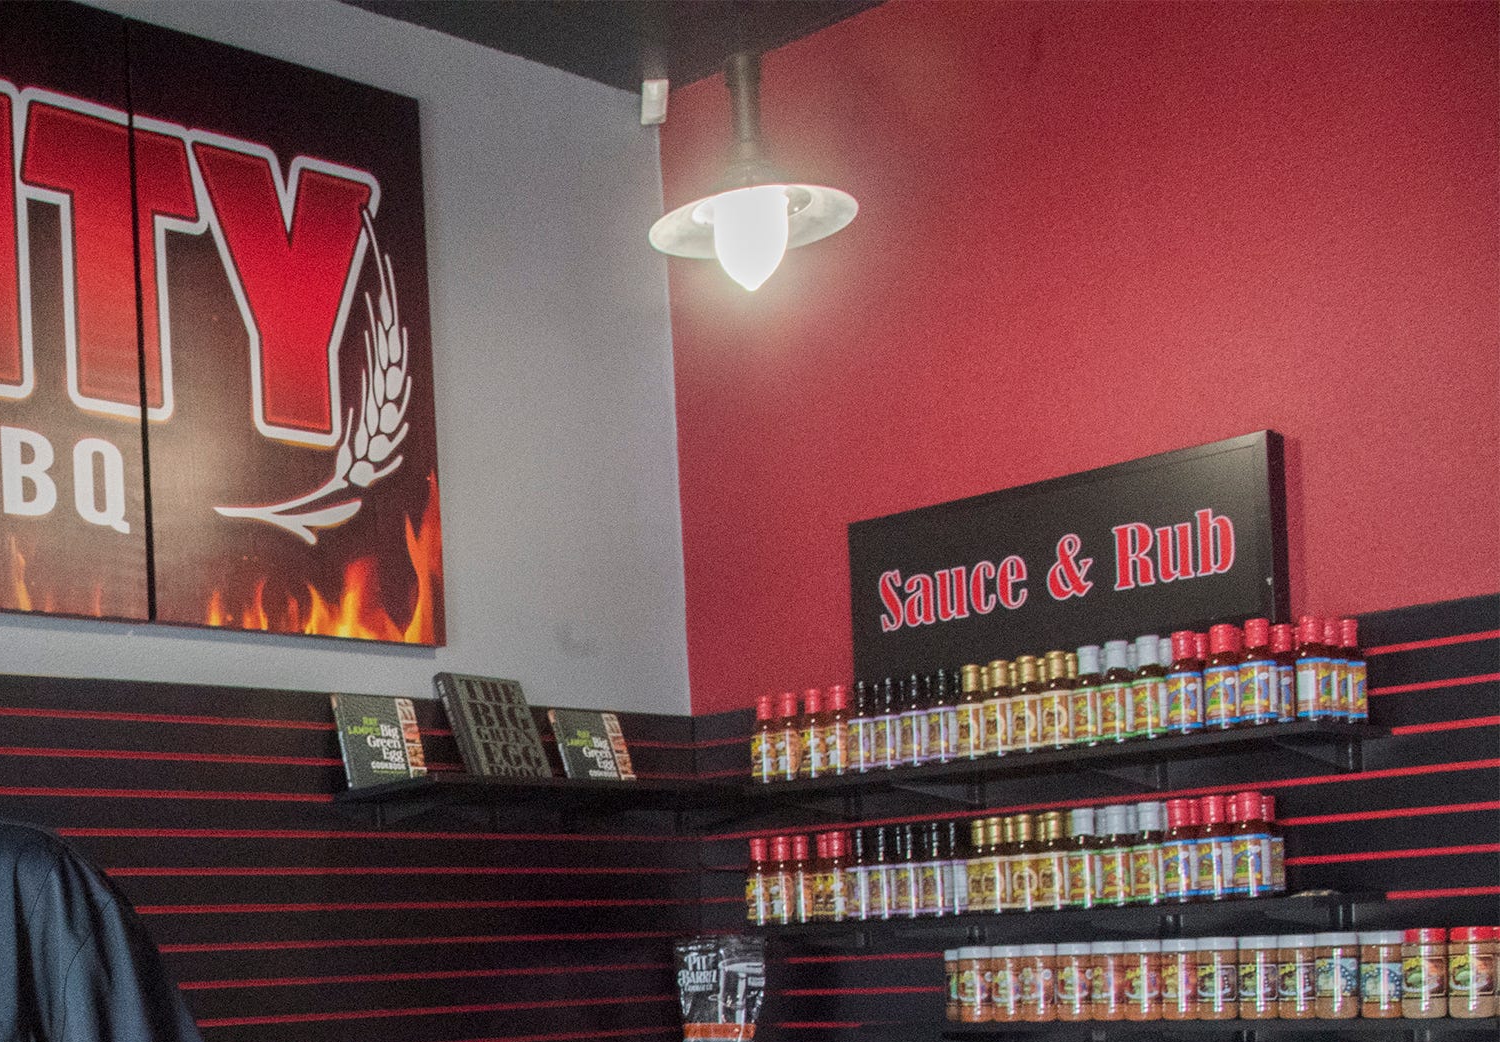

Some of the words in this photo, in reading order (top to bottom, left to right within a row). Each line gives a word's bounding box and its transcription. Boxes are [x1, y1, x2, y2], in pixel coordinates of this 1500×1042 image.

[878, 554, 1029, 633] Sauce
[1047, 532, 1094, 601] &
[1112, 507, 1236, 592] Rub
[380, 724, 400, 740] Big
[367, 734, 402, 749] Green
[382, 746, 404, 763] Egg
